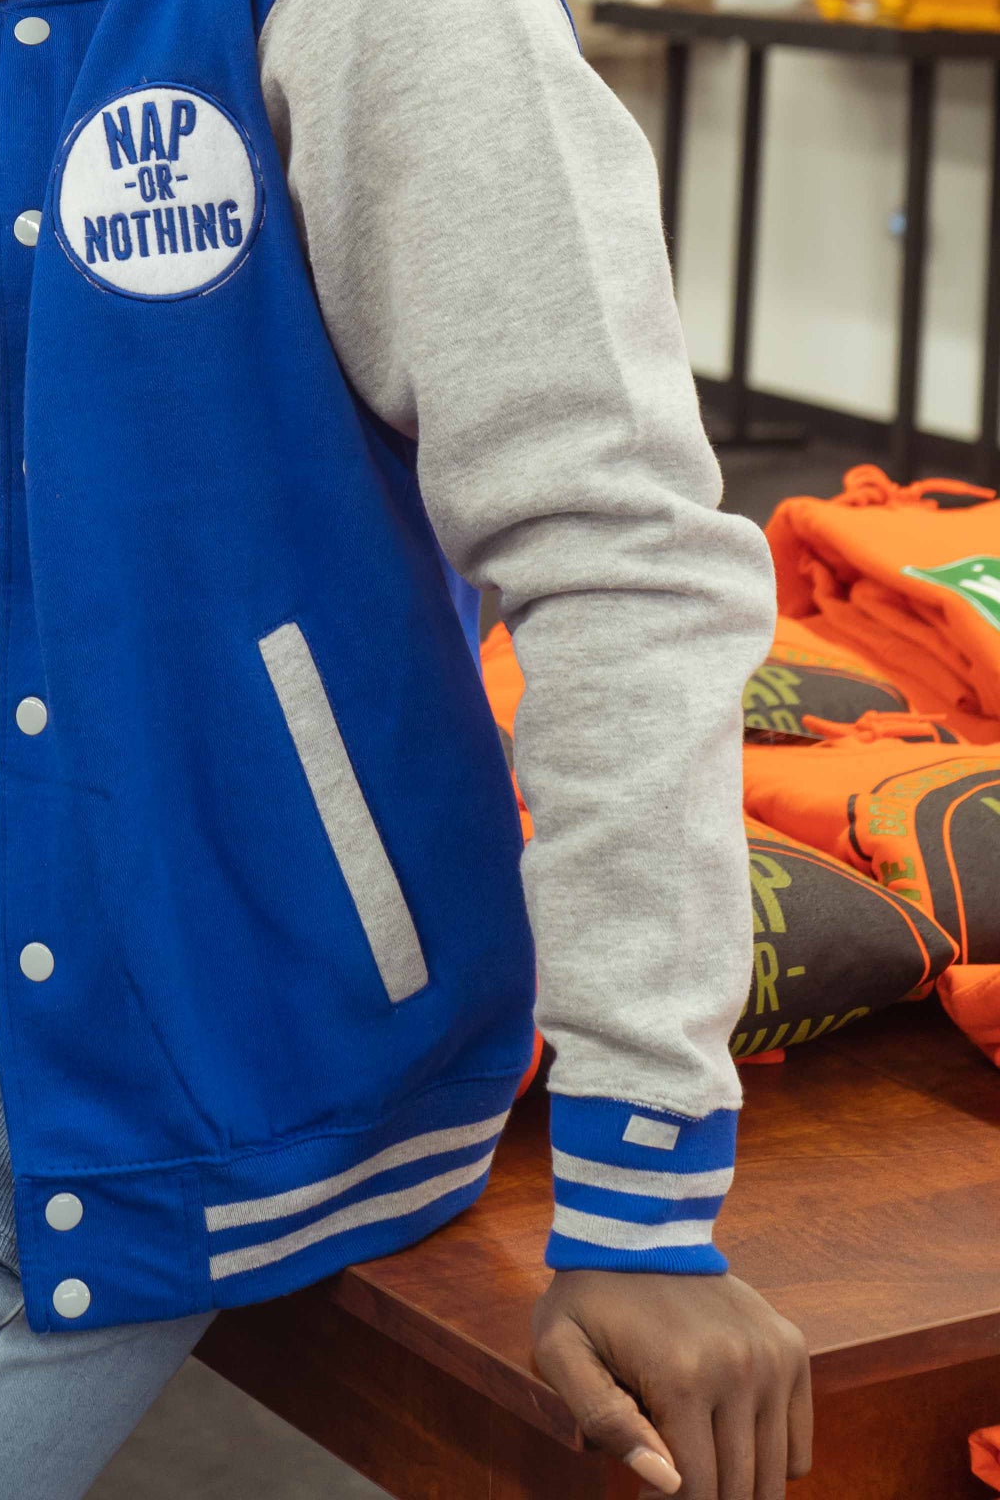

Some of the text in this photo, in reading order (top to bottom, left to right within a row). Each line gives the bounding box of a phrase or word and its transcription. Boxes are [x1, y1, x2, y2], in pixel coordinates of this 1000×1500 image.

[101, 99, 197, 170] NAP
[124, 163, 189, 203] -OR-
[83, 198, 244, 264] NOTHING
[741, 665, 802, 708] AP
